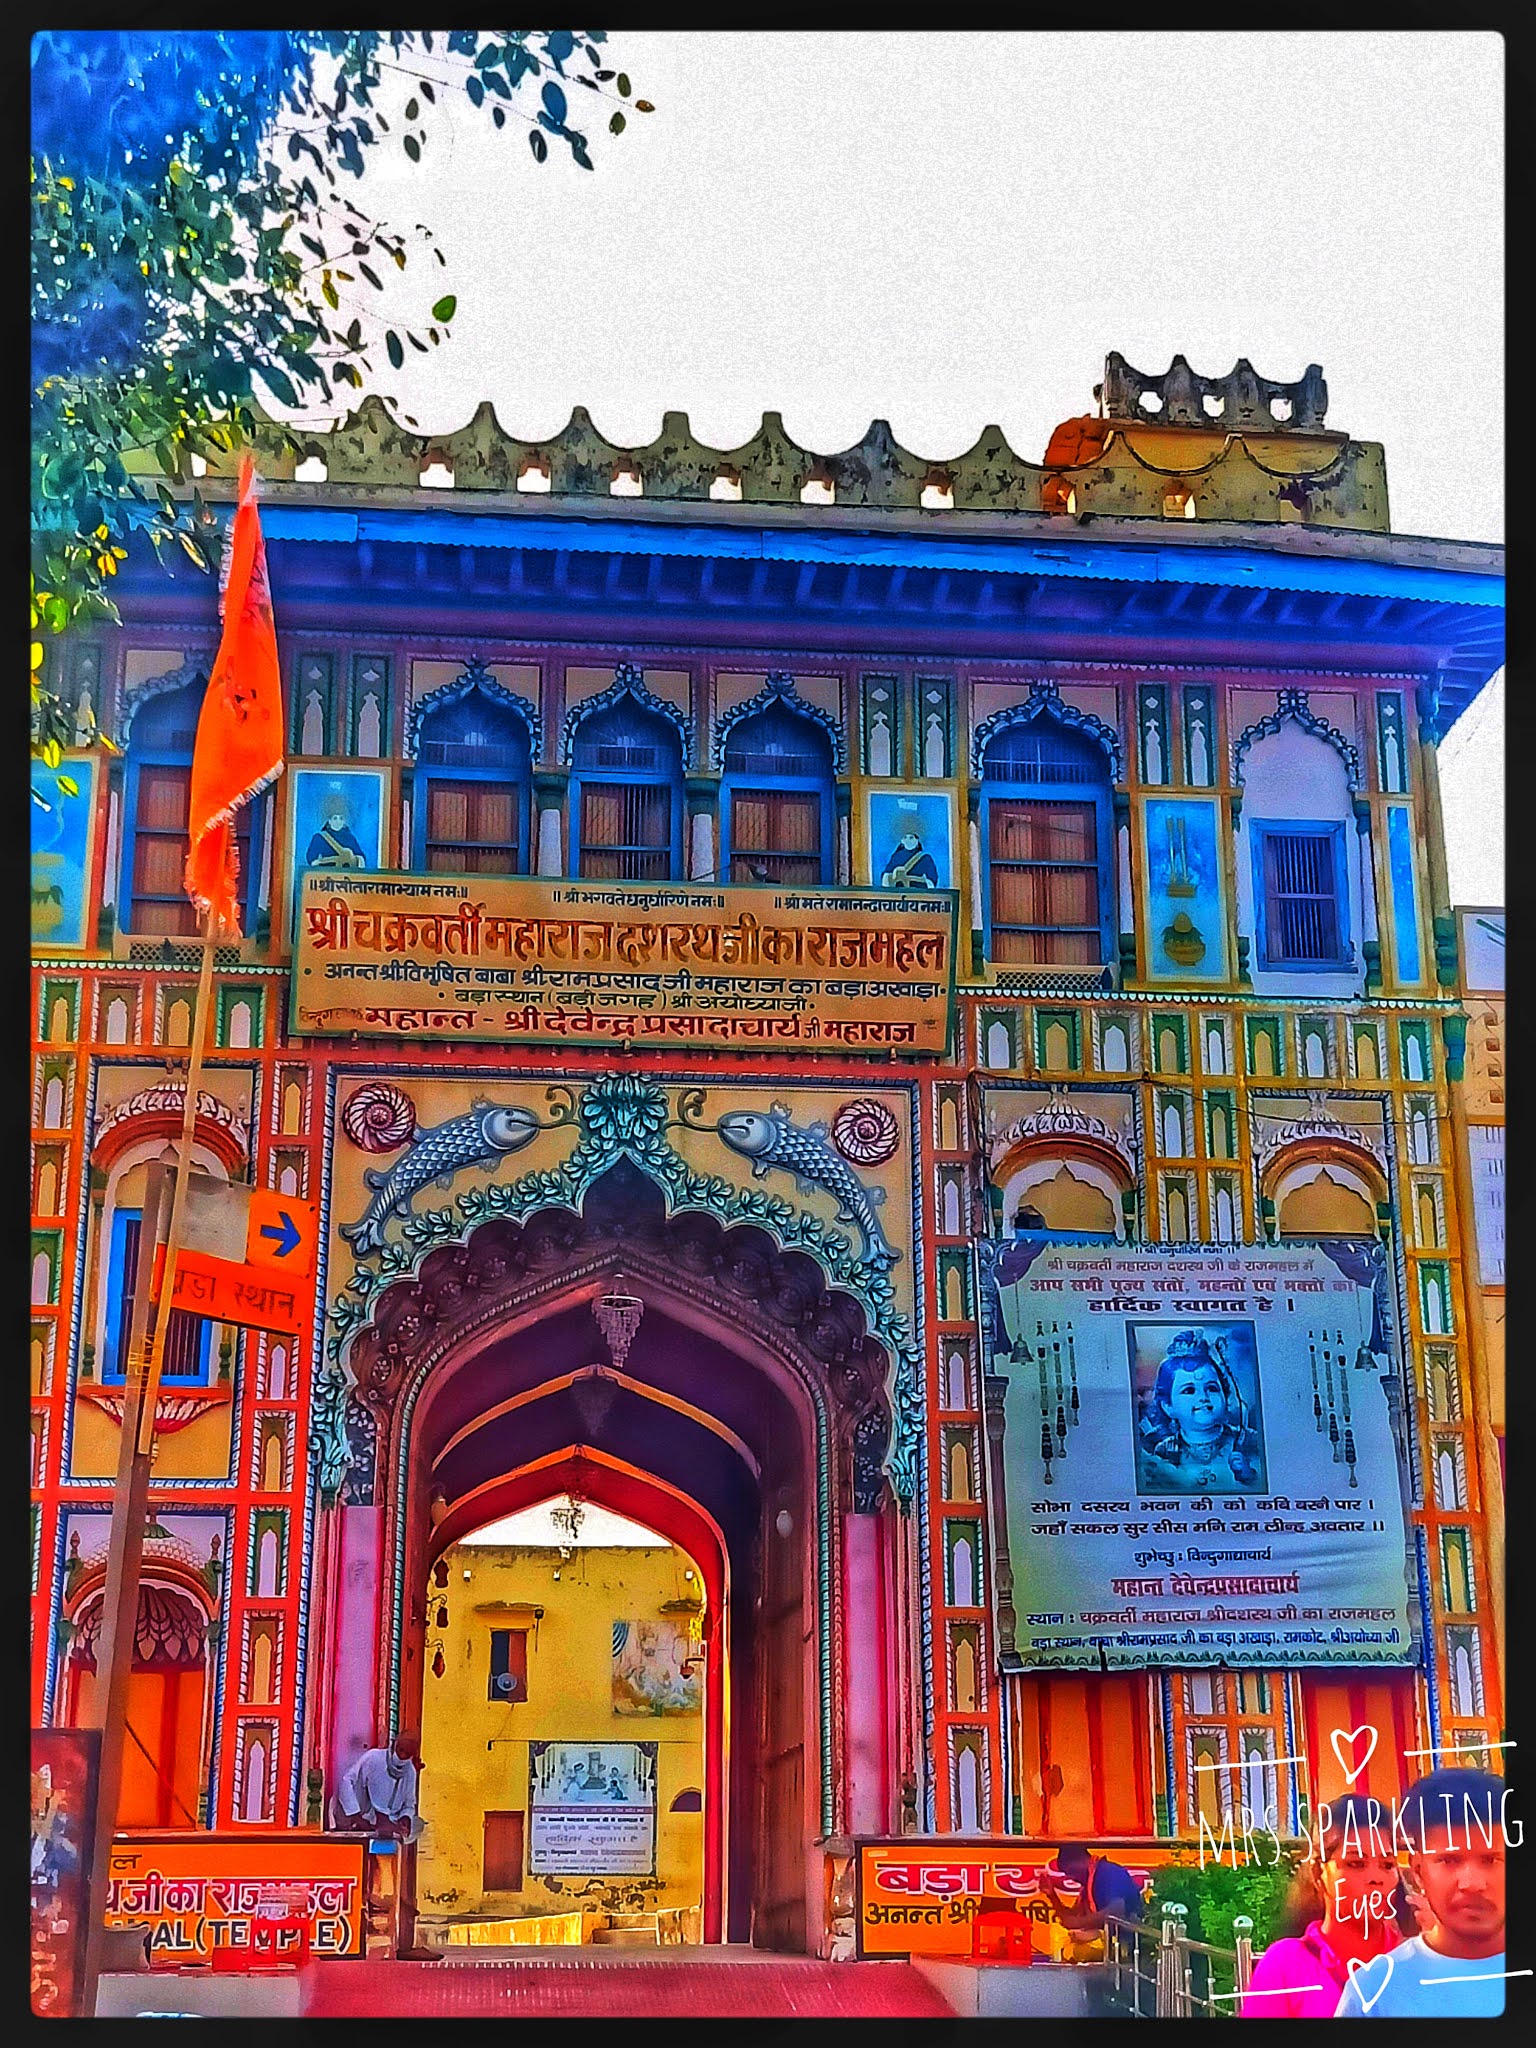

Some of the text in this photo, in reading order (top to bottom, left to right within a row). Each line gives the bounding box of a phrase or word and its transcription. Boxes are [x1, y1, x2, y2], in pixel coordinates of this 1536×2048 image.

[305, 897, 947, 973] श्री चक्रवर्ती महाराज दशरथ जी का राजमहल
[324, 962, 379, 981] अनन्त
[474, 967, 517, 985] बाबा
[694, 975, 786, 995] महाराज
[789, 978, 823, 995] का
[454, 989, 491, 1006] बड़ा
[671, 992, 693, 1008] श्री
[365, 1007, 477, 1030] महान्त
[505, 1005, 541, 1031] श्री
[543, 1006, 638, 1037] देवेन्द्र
[804, 1016, 821, 1039] जी
[824, 1020, 917, 1045] महाराज
[1048, 1257, 1063, 1271] श्री
[1066, 1257, 1112, 1272] चक्रवर्ती
[1116, 1260, 1162, 1272] महाराज
[1207, 1257, 1224, 1271] जी
[1030, 1279, 1064, 1292] आप
[1070, 1277, 1104, 1292] सभी
[1110, 1279, 1145, 1295] पूज्य
[1087, 1296, 1162, 1312] हार्दिक
[1172, 1299, 1247, 1312] स्वागत
[1252, 1296, 1274, 1312] है
[1031, 1498, 1071, 1513] सोभा
[1140, 1500, 1180, 1511] भवन
[1190, 1497, 1213, 1511] की
[1224, 1497, 1246, 1511] को
[1334, 1499, 1362, 1511] पार
[1070, 1522, 1119, 1534] सकल
[1124, 1522, 1149, 1538] सुर
[1153, 1518, 1188, 1534] सीस
[1231, 1521, 1259, 1533] राम
[1310, 1520, 1365, 1533] अवतार
[1142, 1610, 1201, 1624] महाराज
[1277, 1604, 1297, 1620] जी
[1302, 1608, 1323, 1620] का
[1328, 1607, 1396, 1621] राजमहल
[1181, 1629, 1197, 1645] जी
[875, 1861, 989, 1903] बड़ा
[865, 1902, 944, 1926] अनन्त
